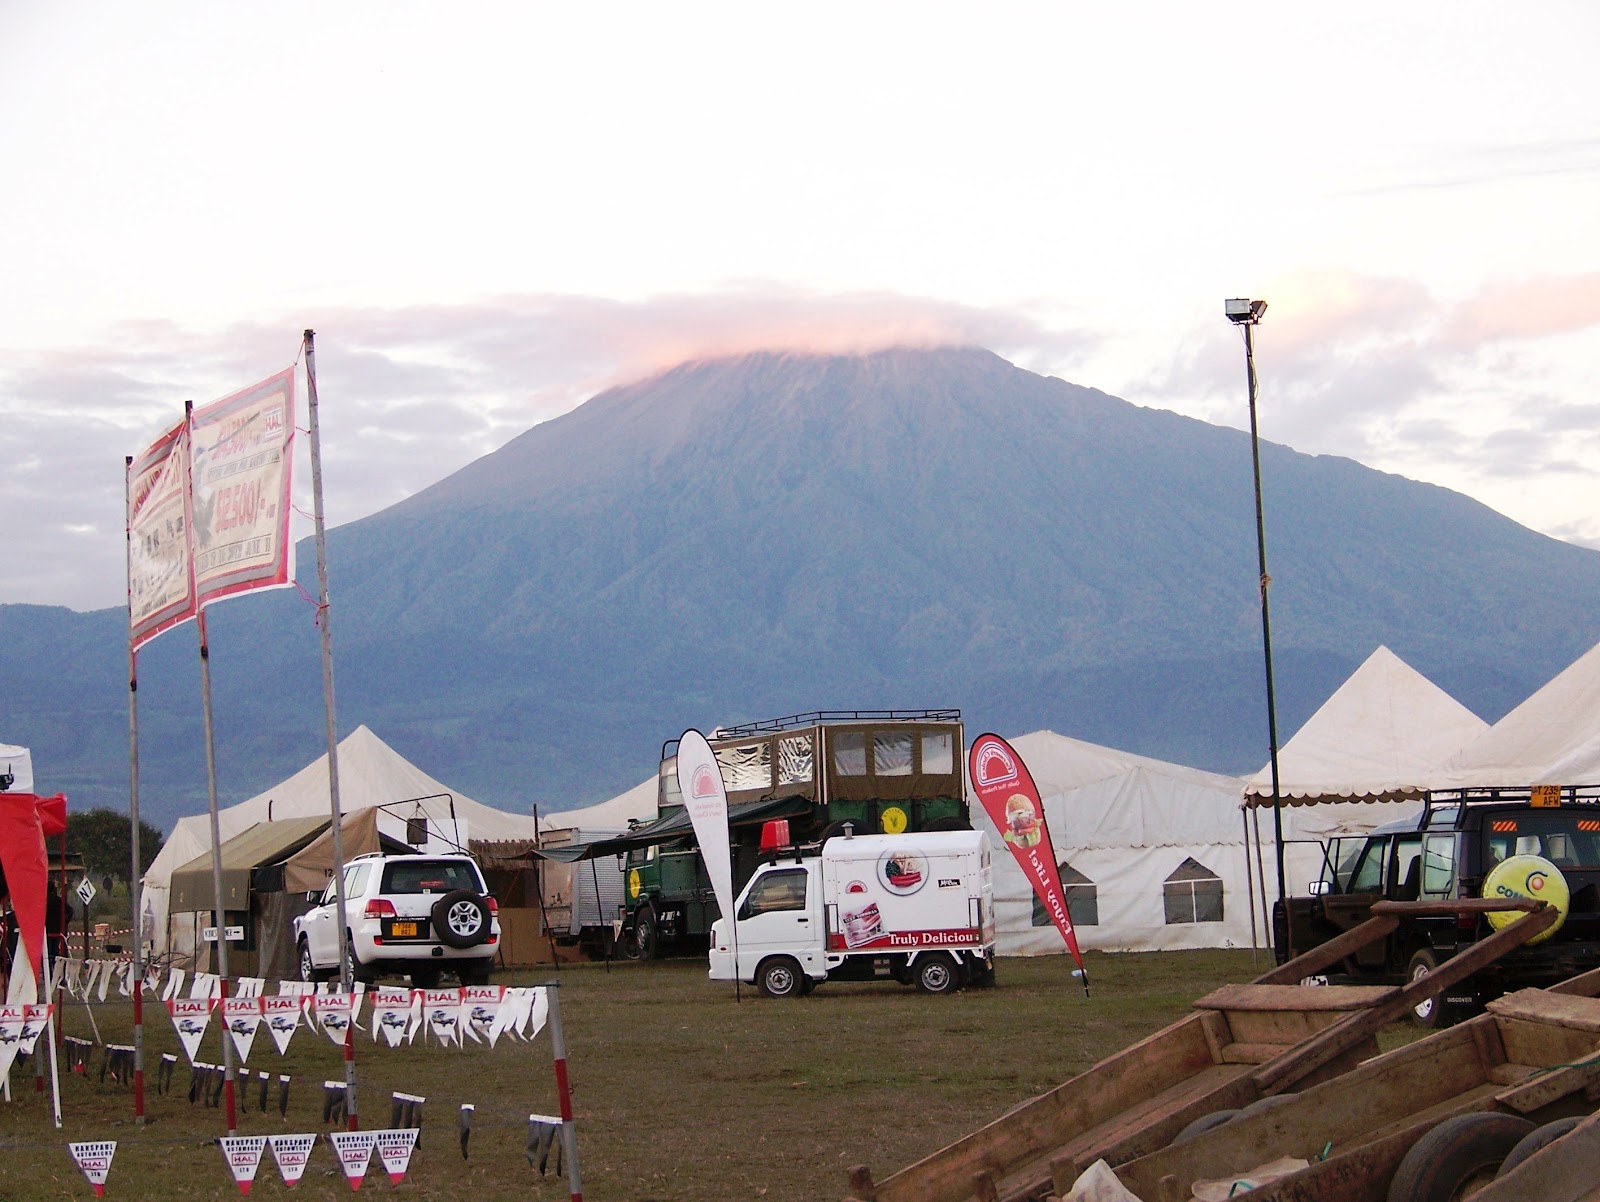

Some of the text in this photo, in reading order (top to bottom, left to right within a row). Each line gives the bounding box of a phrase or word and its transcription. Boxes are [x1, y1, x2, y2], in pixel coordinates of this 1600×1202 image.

[265, 414, 281, 432] HAL
[890, 933, 919, 946] Truly
[378, 995, 408, 1003] HAL
[427, 993, 457, 1002] HAL
[468, 990, 497, 999] HAL
[267, 1000, 297, 1009] HAL
[318, 997, 348, 1006] HAL
[176, 1003, 206, 1012] HAL
[227, 1002, 258, 1011] HAL
[0, 1009, 21, 1017] AL
[27, 1009, 45, 1017] AL
[345, 1151, 366, 1159] HAL
[385, 1148, 406, 1156] HAL
[233, 1154, 254, 1162] HAL
[282, 1154, 303, 1162] HAL
